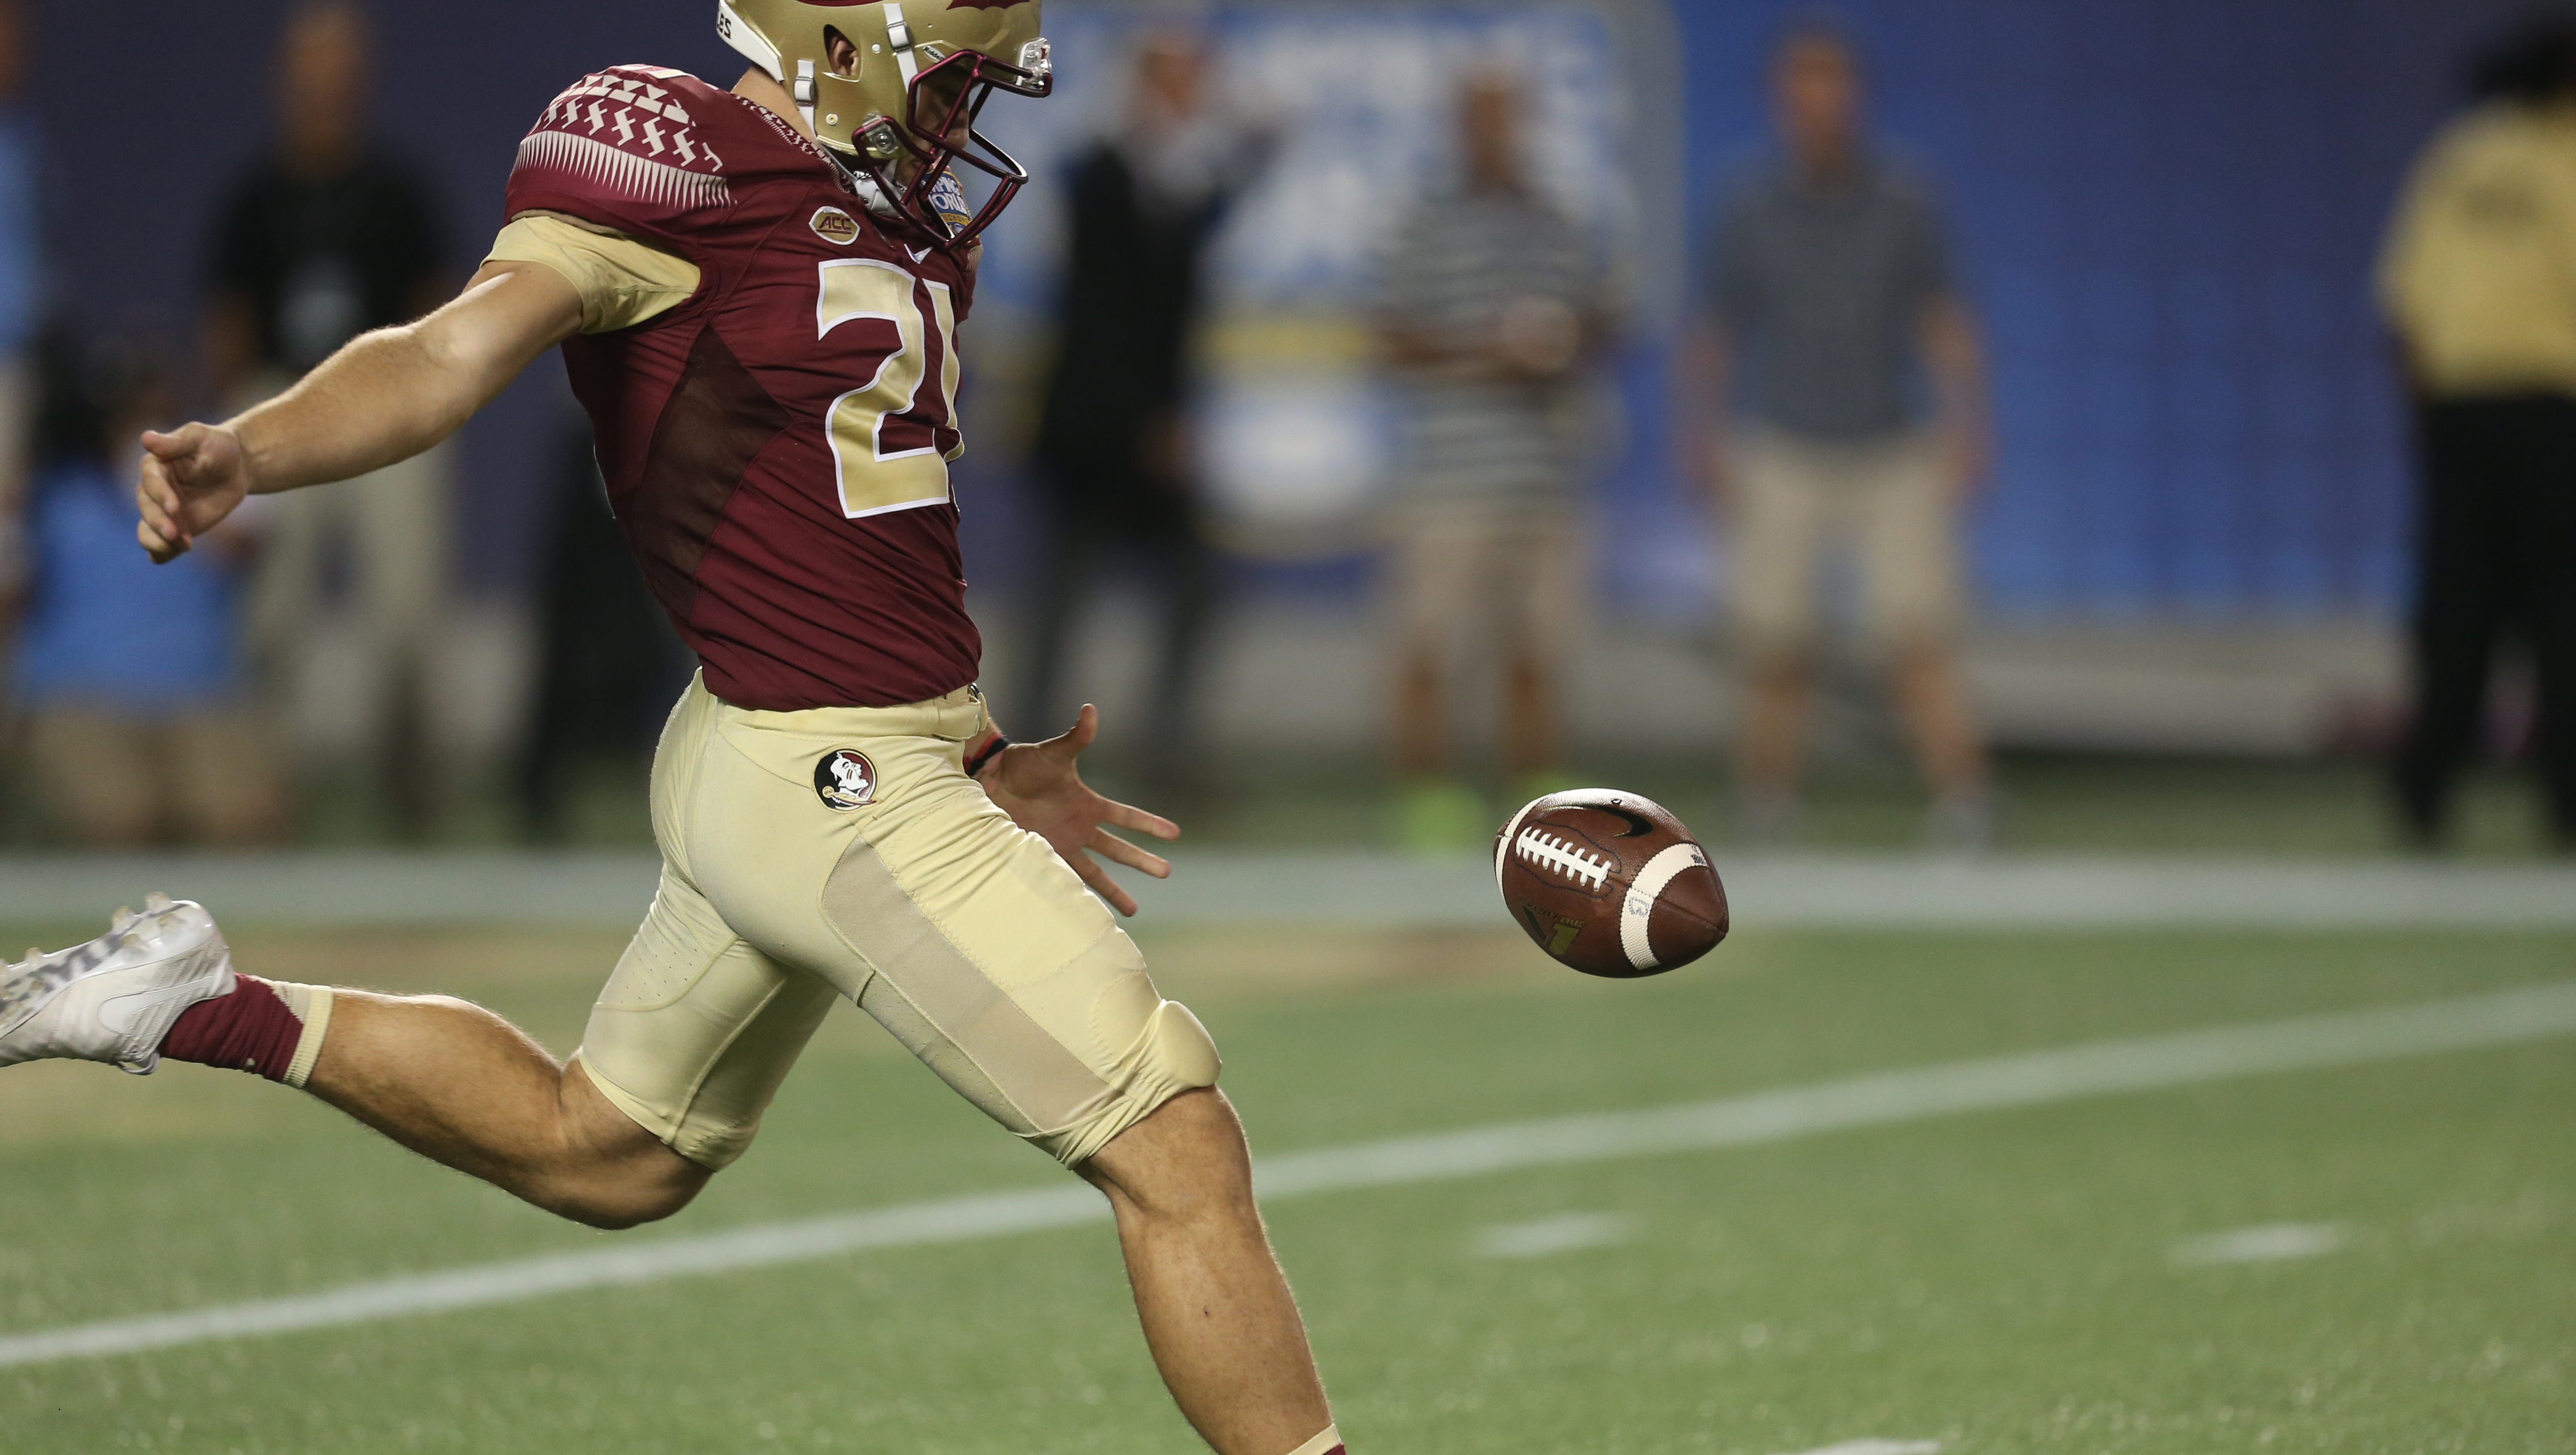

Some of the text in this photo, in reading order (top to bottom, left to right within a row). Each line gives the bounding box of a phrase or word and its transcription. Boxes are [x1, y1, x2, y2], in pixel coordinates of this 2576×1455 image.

[931, 192, 968, 214] ORLD
[818, 216, 852, 231] ACC
[816, 257, 965, 519] 21
